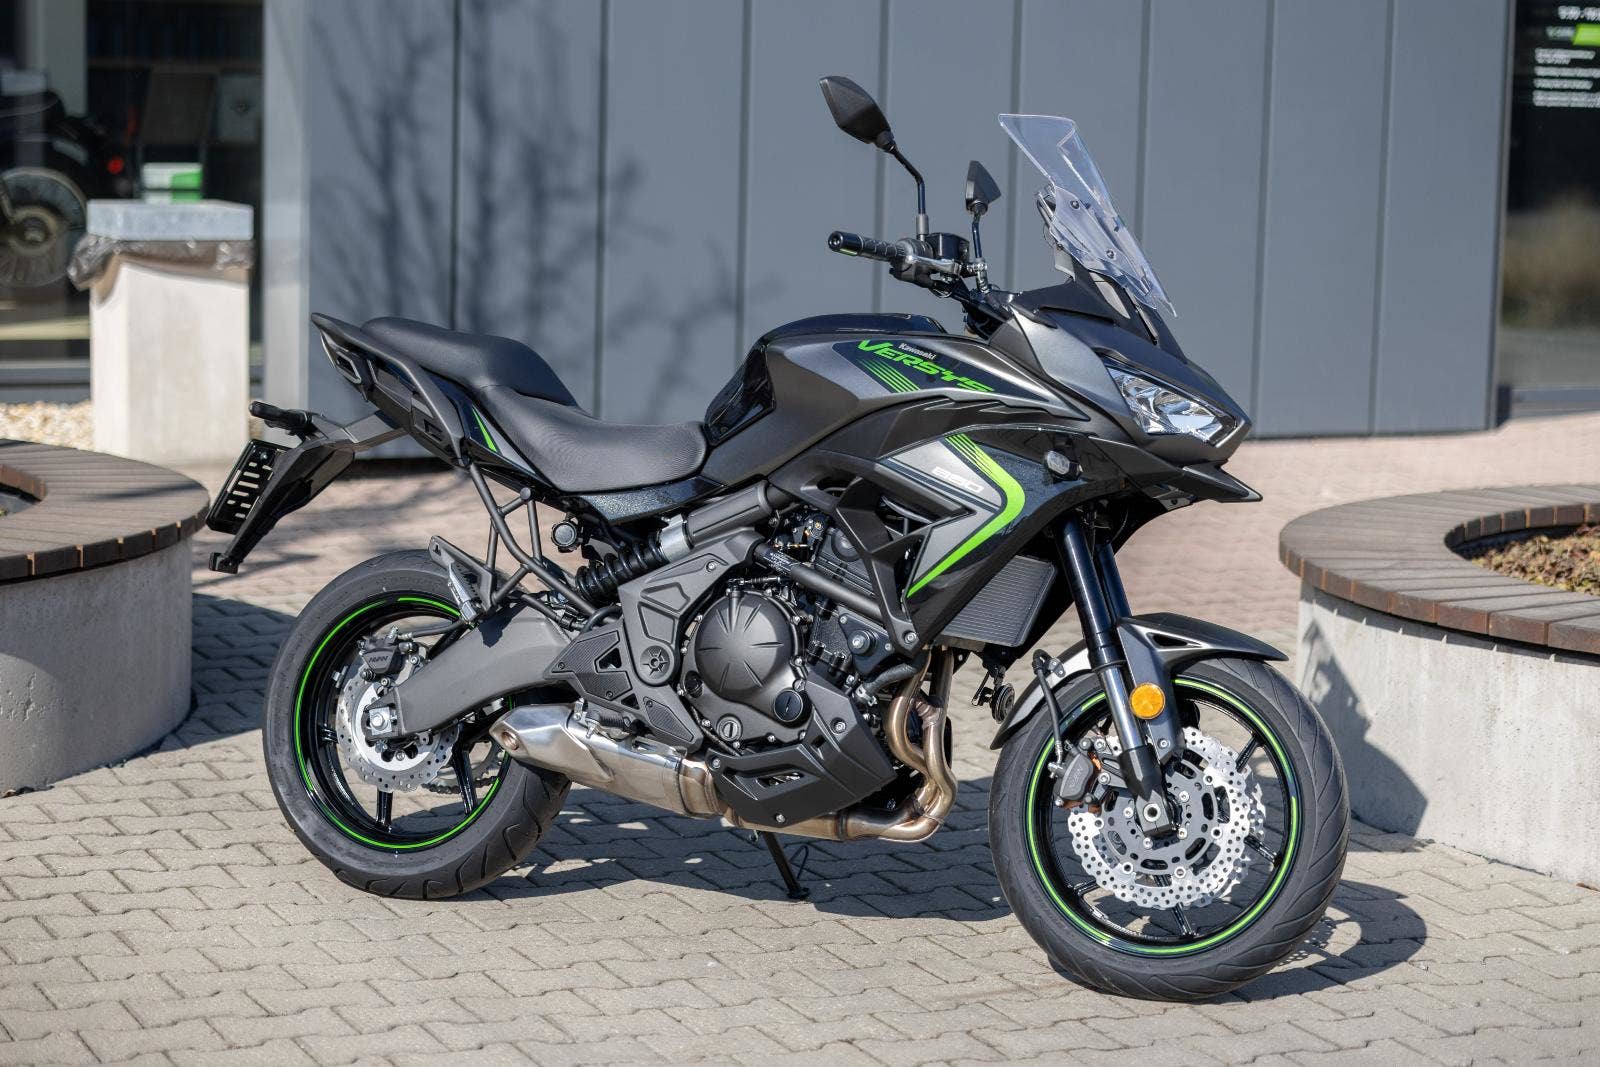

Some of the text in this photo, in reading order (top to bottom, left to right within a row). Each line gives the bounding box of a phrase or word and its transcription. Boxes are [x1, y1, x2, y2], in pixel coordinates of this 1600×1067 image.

[898, 343, 936, 360] Kawasaki
[857, 340, 994, 392] VERSYS
[932, 466, 985, 493] 650
